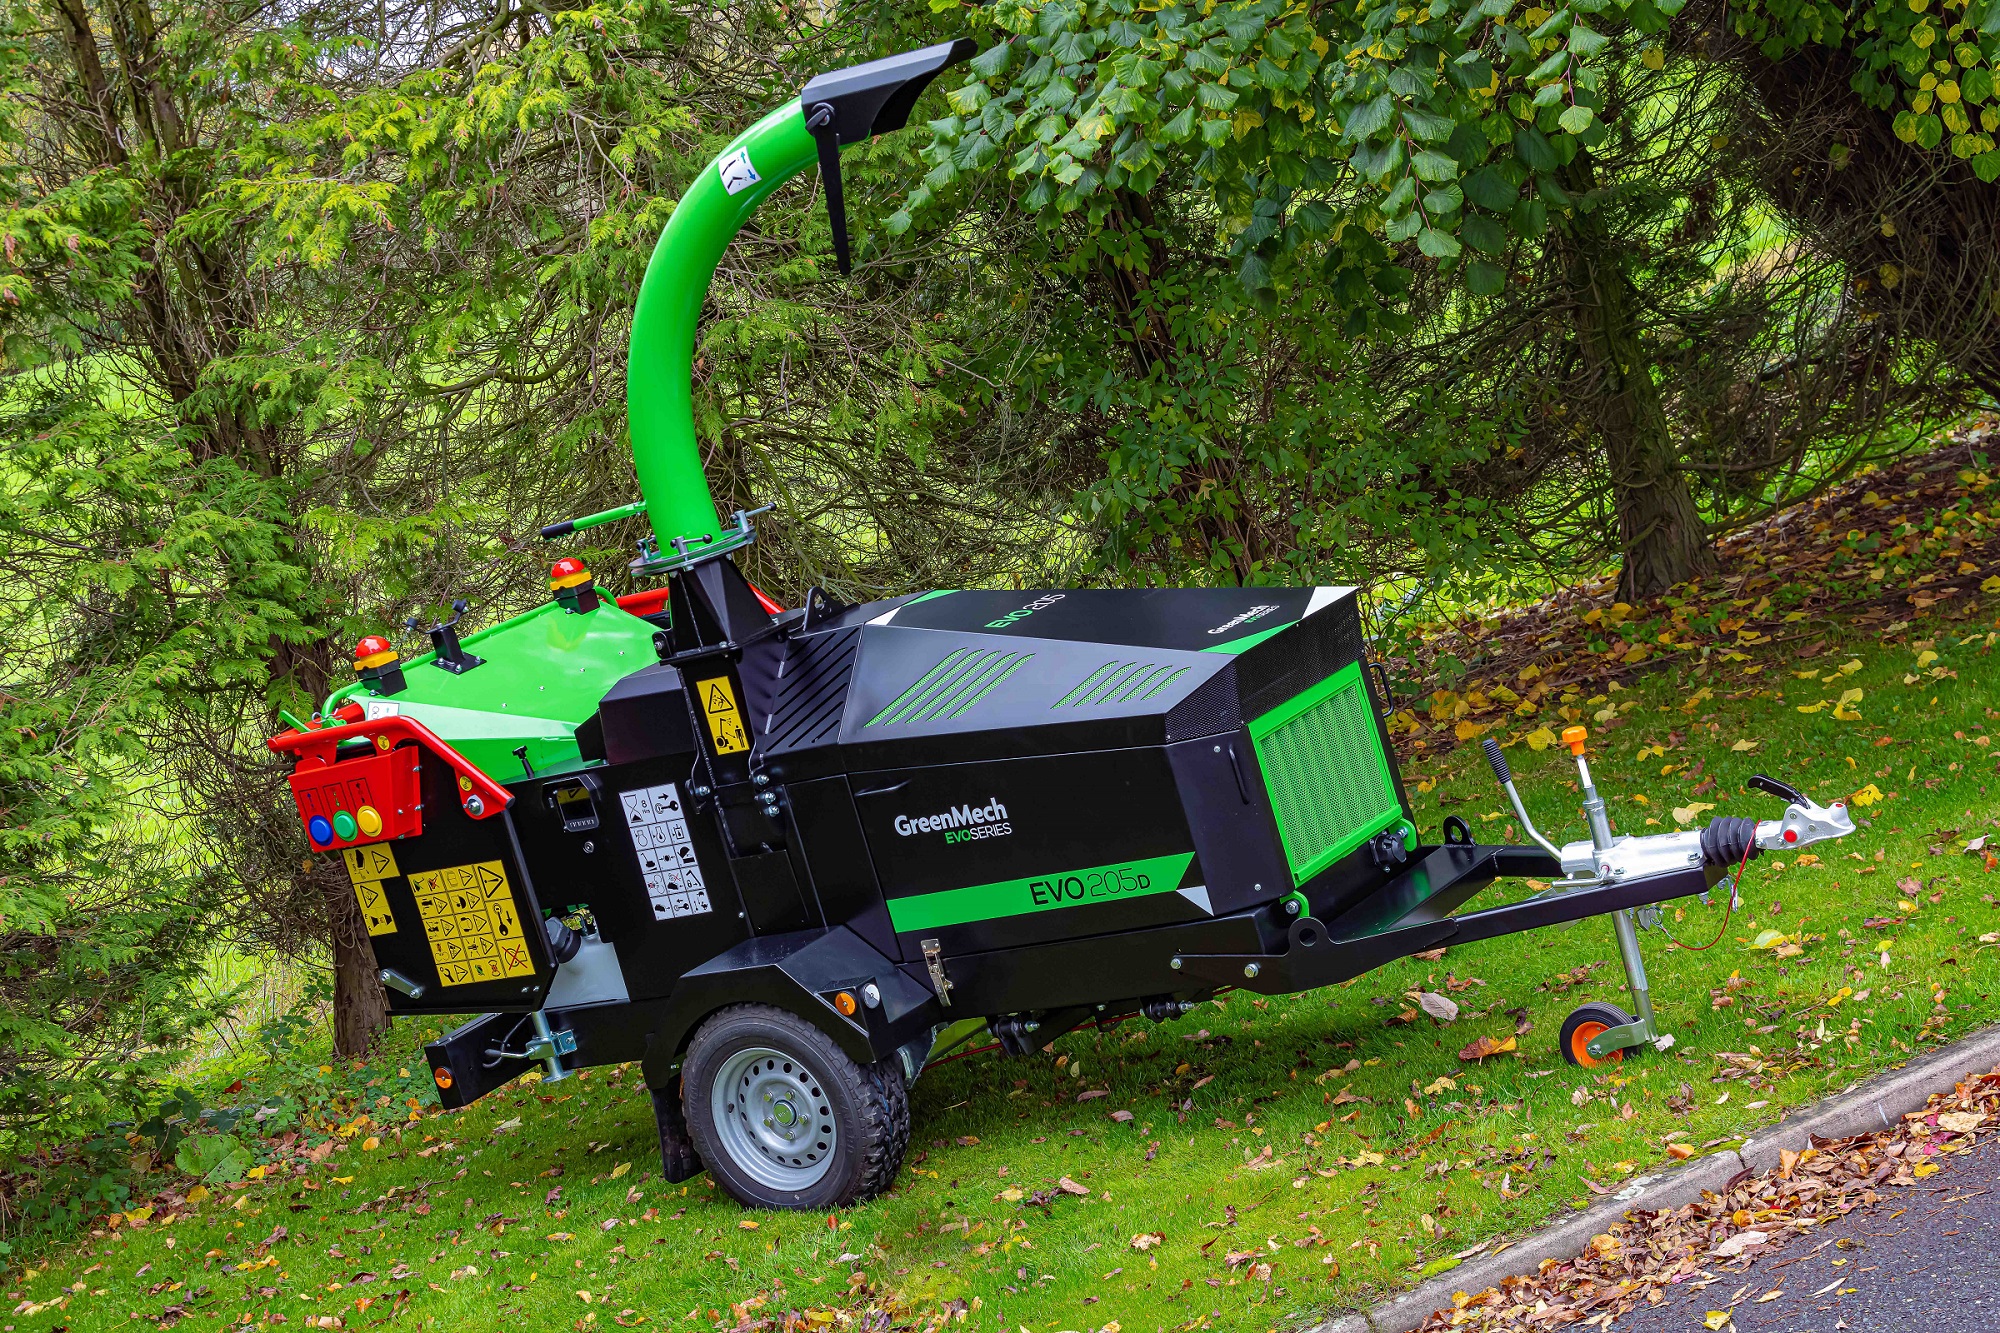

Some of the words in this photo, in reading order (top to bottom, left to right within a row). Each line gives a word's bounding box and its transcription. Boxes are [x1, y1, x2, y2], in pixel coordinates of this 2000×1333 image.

[984, 609, 1033, 628] EVO
[1022, 594, 1066, 610] 205
[641, 799, 648, 809] 8
[894, 797, 1008, 836] GreenMech
[1029, 876, 1085, 905] EVO
